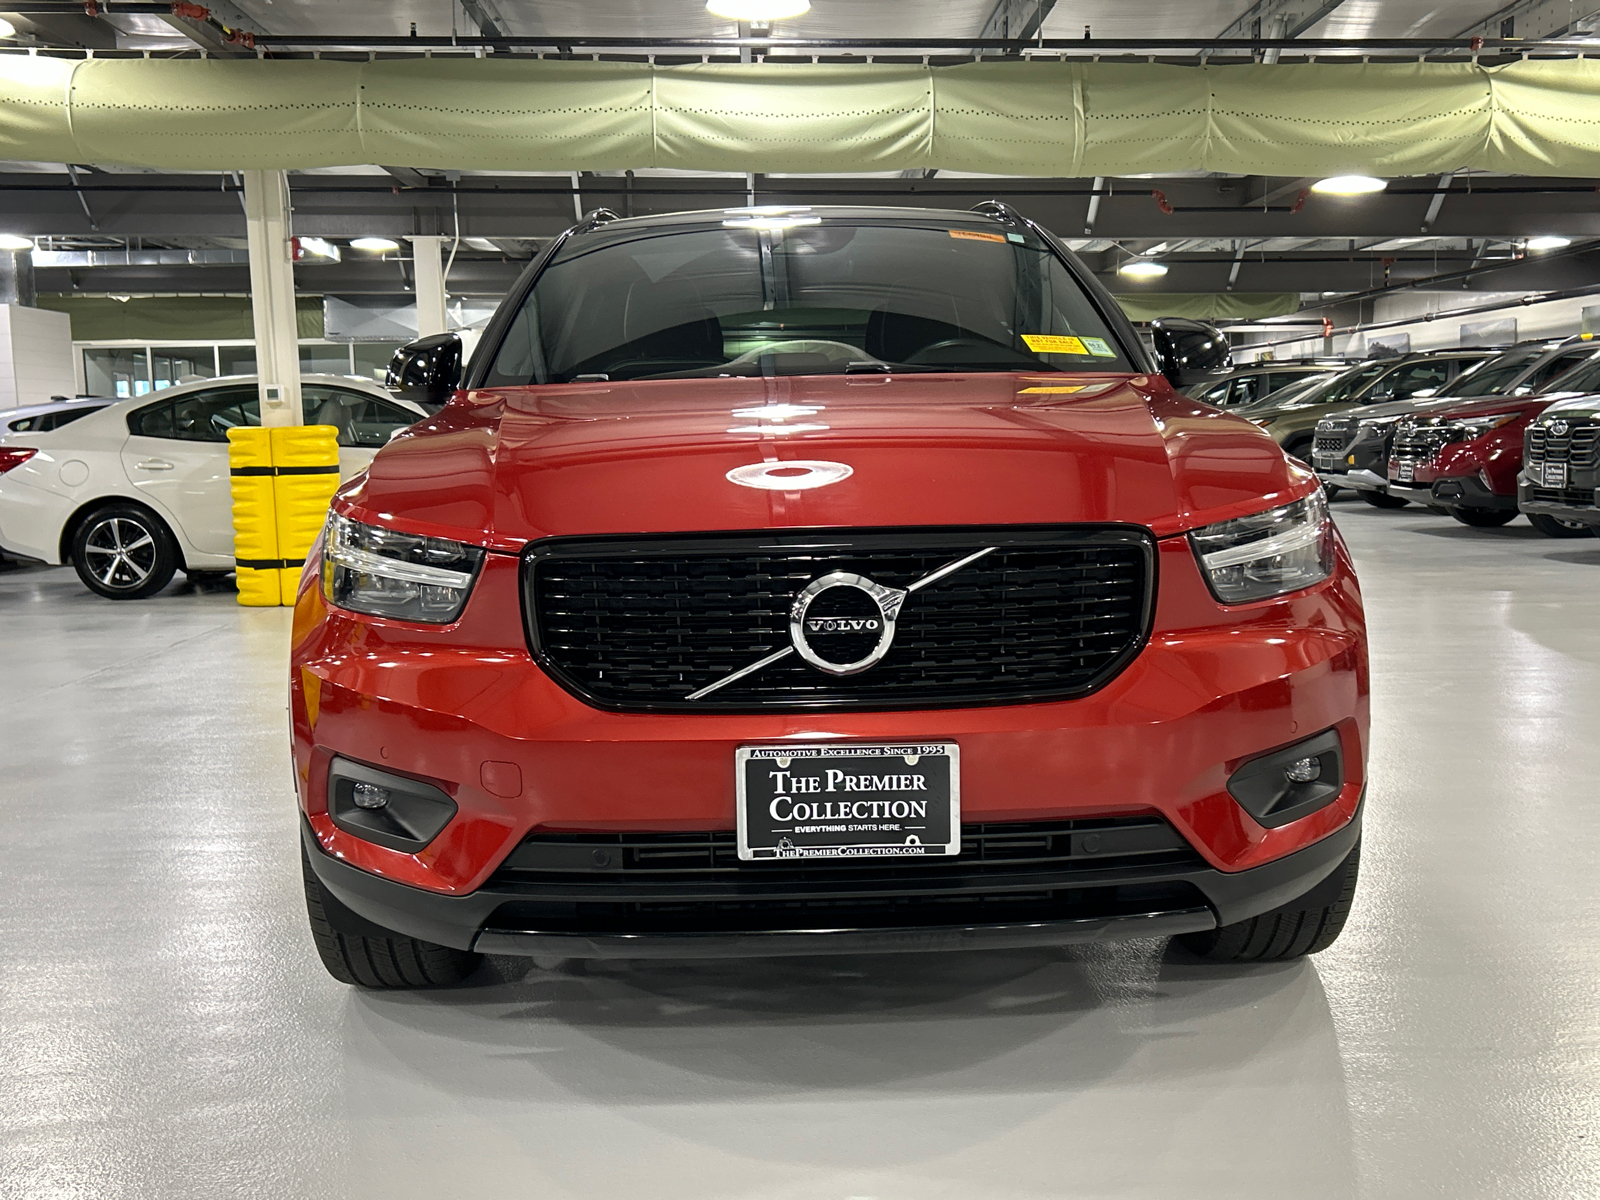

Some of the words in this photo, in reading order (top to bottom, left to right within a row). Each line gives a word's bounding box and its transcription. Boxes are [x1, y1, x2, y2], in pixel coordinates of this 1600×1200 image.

[806, 619, 879, 631] VOLVO
[752, 749, 818, 758] AUTOMOTIVE
[820, 748, 882, 757] EXCELLENCE
[883, 747, 914, 755] SINCE
[916, 745, 944, 754] 1995
[769, 770, 821, 794] THE
[825, 769, 927, 792] PREMIER
[769, 796, 927, 821] COLLECTION
[794, 824, 846, 833] EVERYTHING
